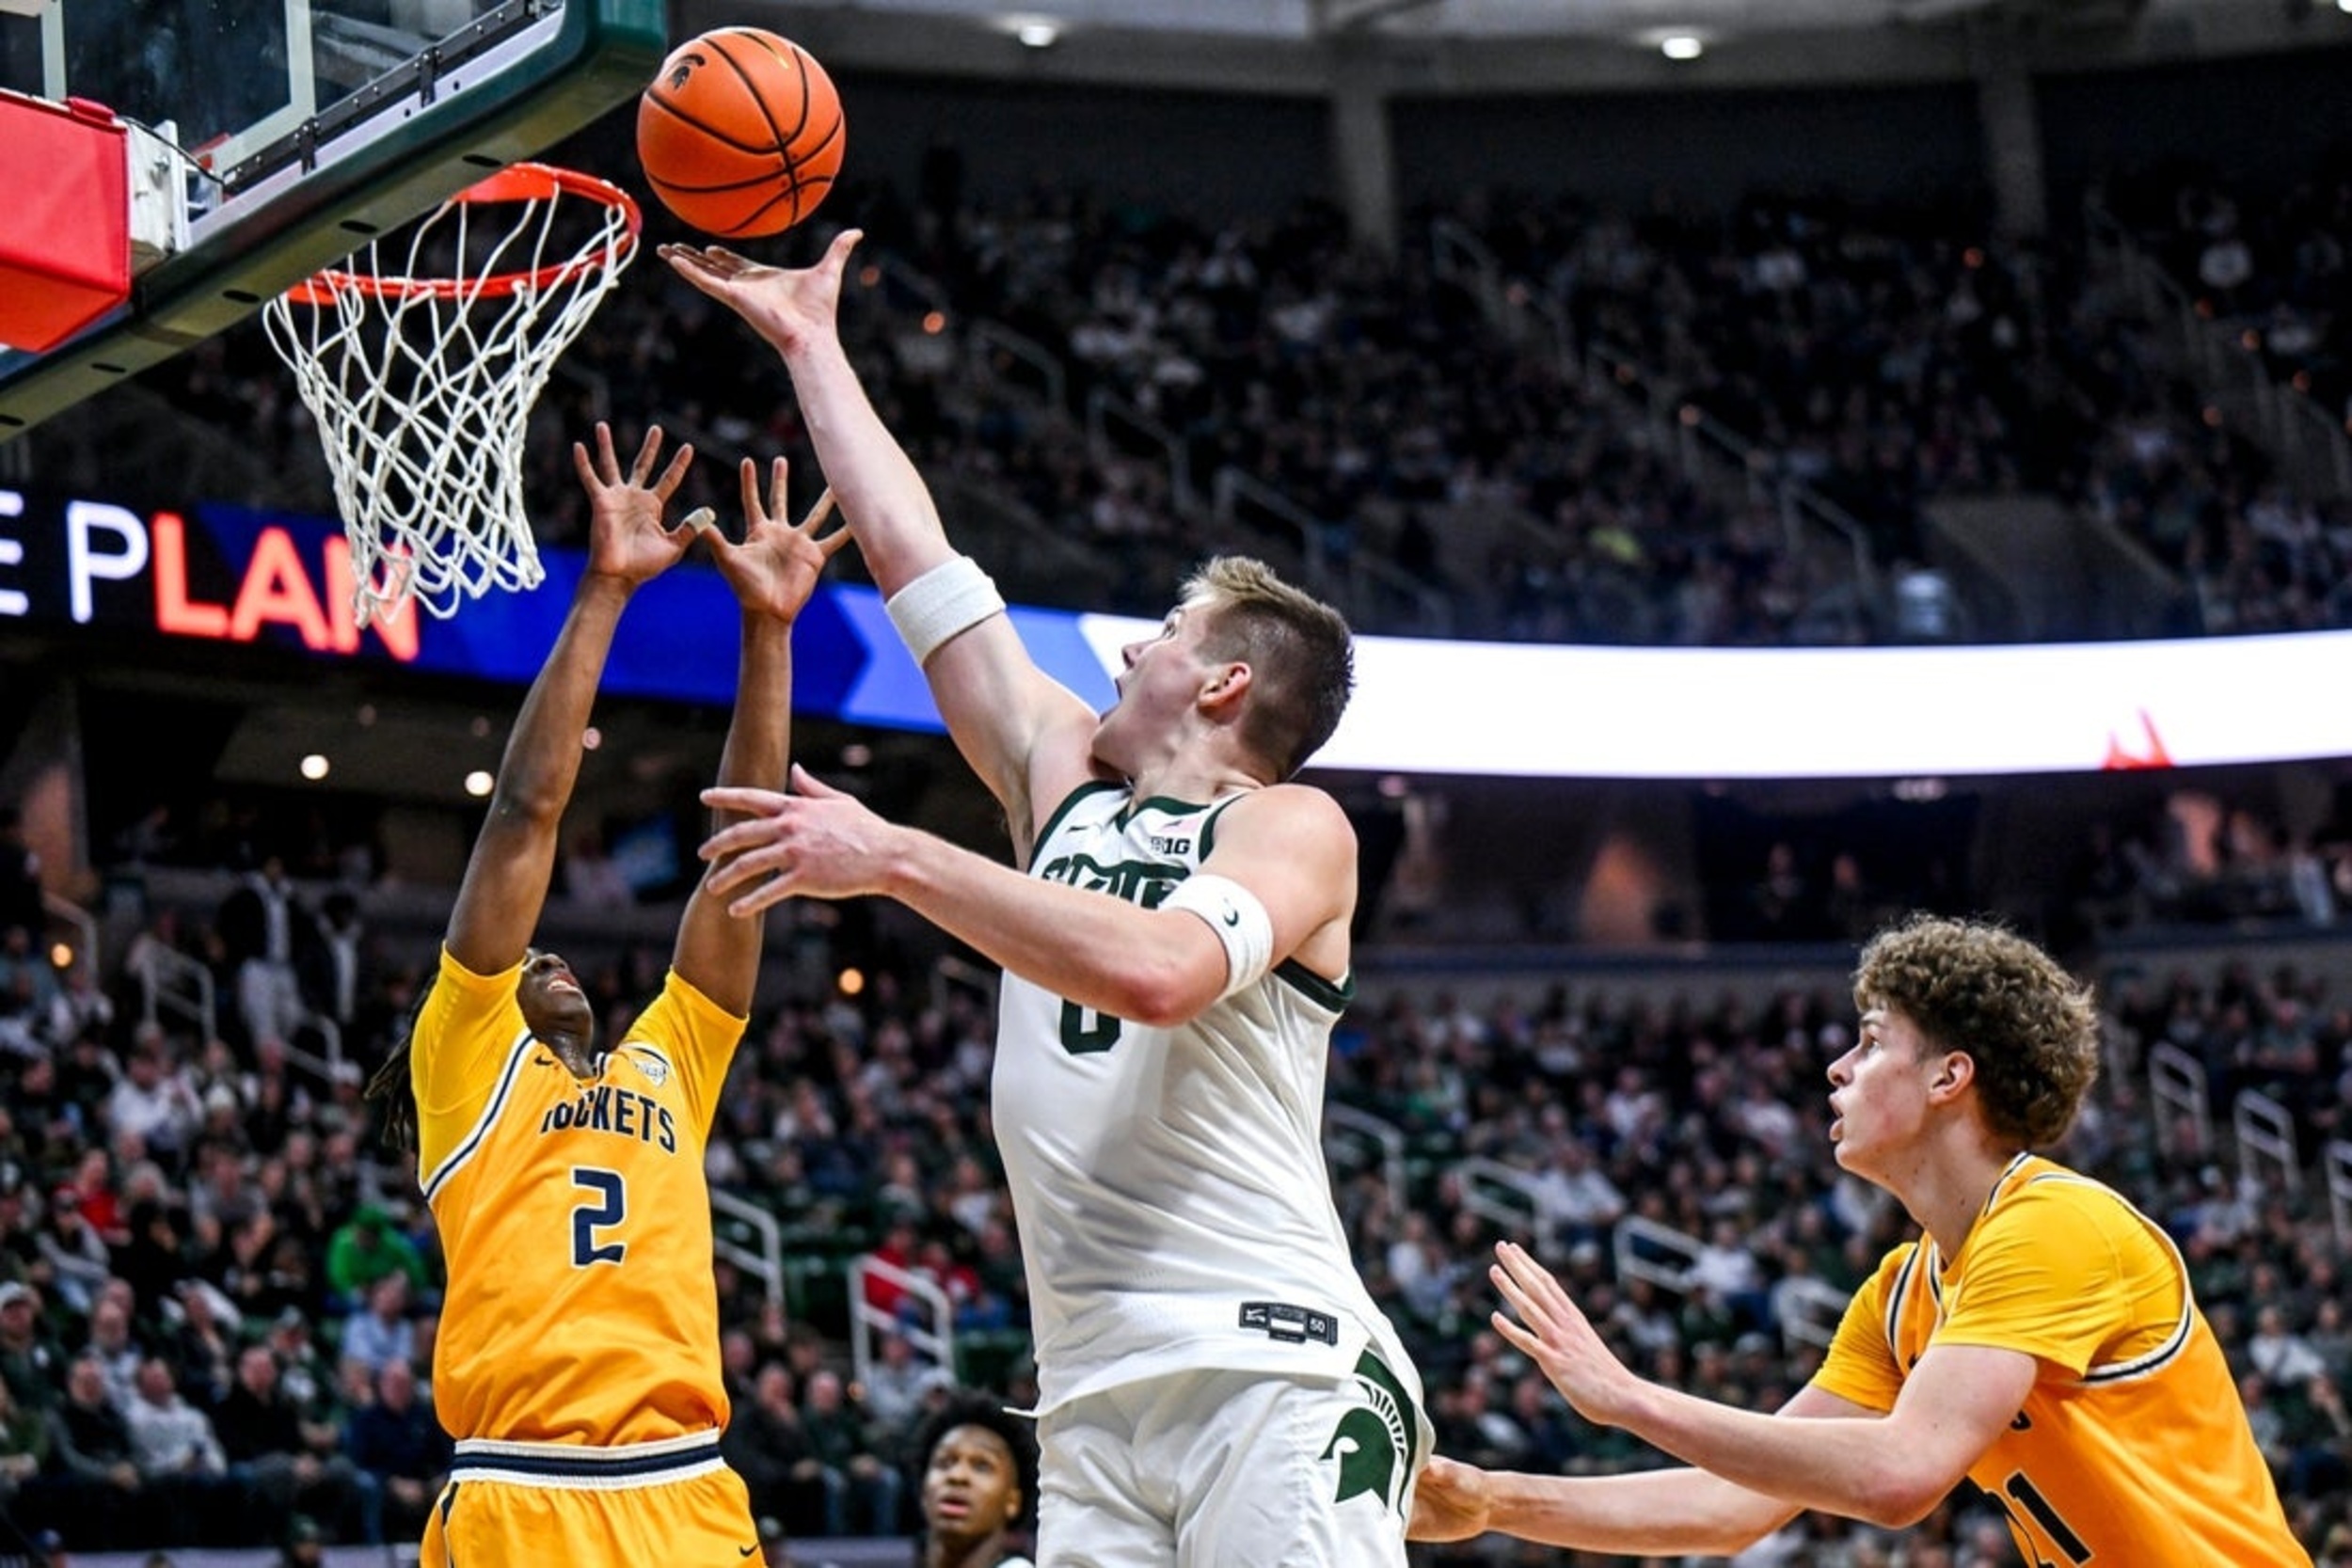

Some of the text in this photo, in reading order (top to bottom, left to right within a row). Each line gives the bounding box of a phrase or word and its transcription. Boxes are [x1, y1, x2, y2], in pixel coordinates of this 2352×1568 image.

[67, 499, 419, 662] PLAN
[571, 1165, 625, 1266] 2
[1309, 1317, 1326, 1334] 50
